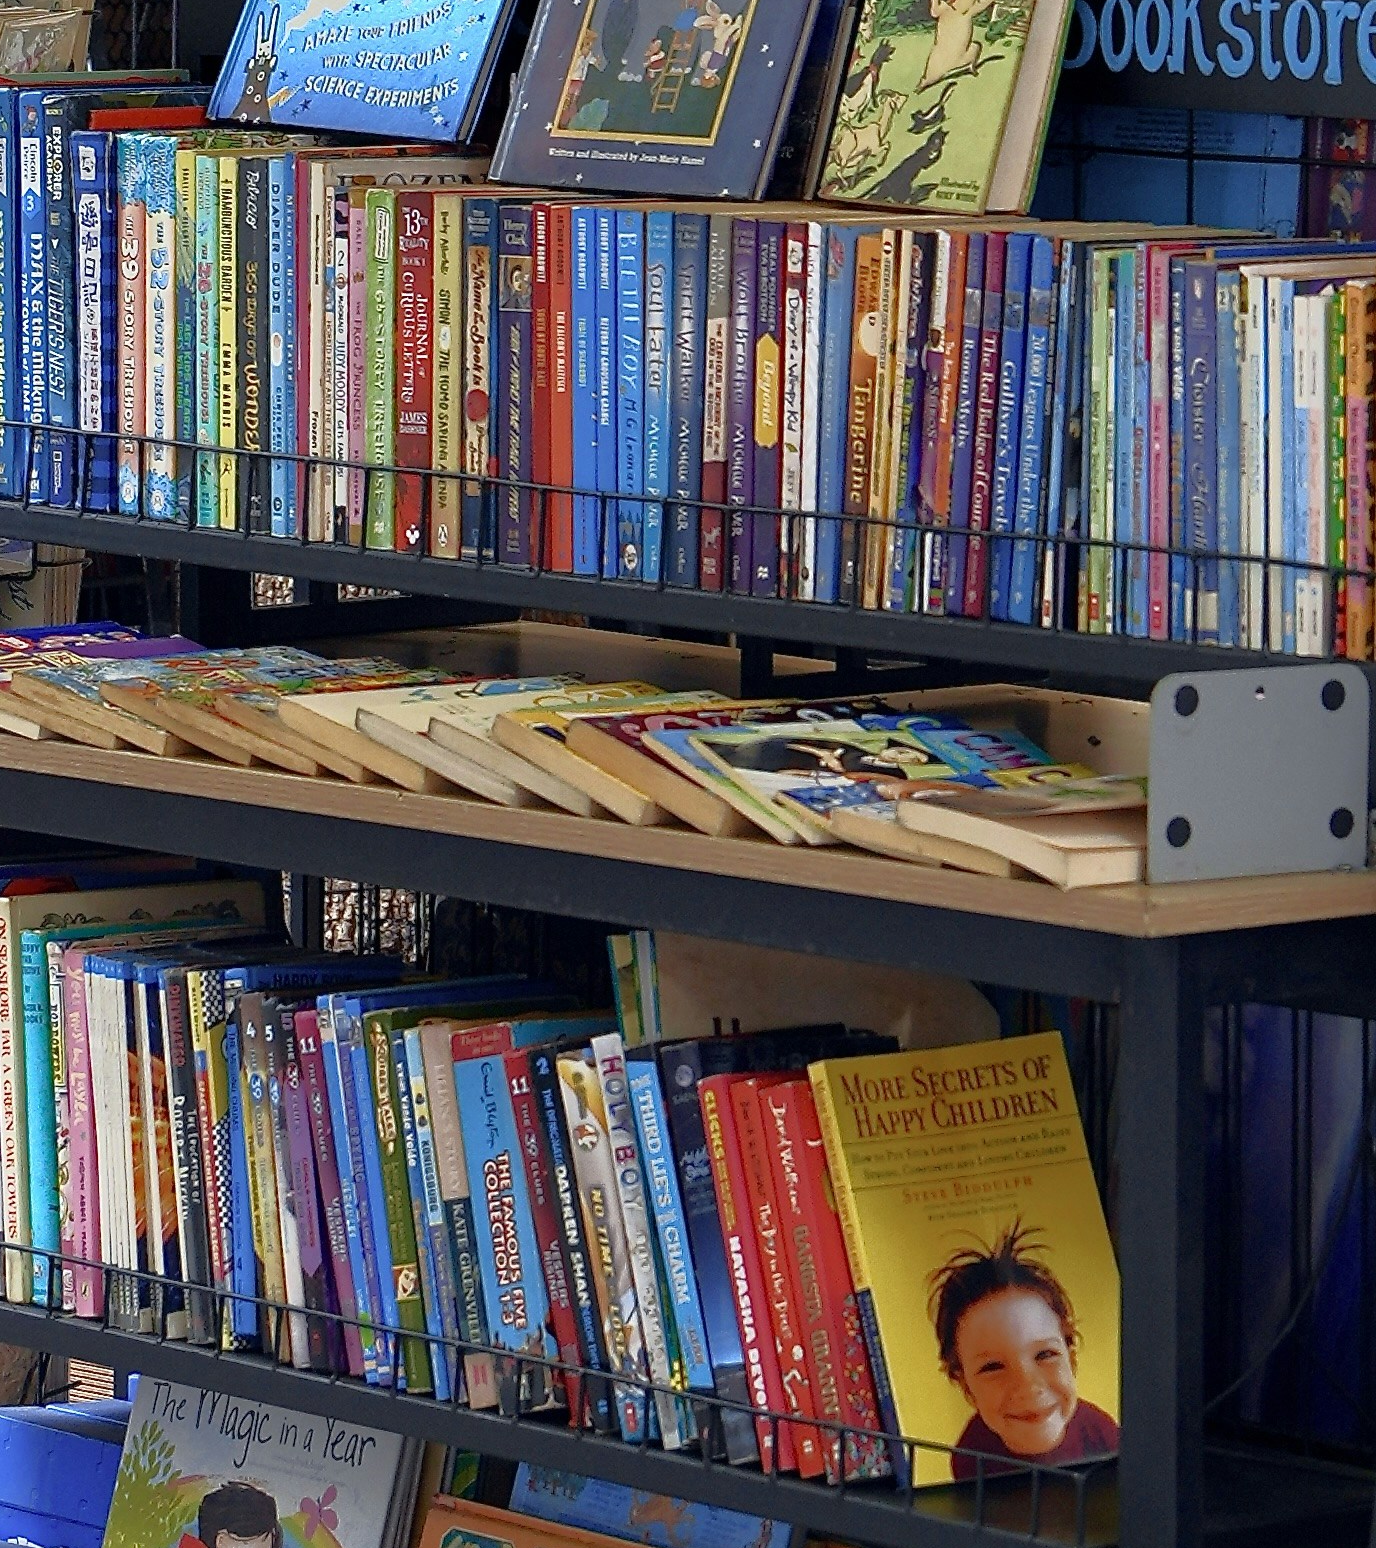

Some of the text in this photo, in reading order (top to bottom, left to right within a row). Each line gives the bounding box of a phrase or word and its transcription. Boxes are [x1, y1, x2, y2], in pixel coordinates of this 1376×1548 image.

[302, 24, 355, 53] AMAZE
[388, 2, 453, 38] FRIENDS
[323, 42, 453, 72] WITH SPECTACULAR
[304, 75, 460, 108] SCIENCE EXPERIMENTS
[840, 1054, 1051, 1105] MORE SECRETS OF
[853, 1088, 1060, 1139] HAPPY CHILDREN
[902, 1175, 1034, 1203] STEVE BIDDULPH
[483, 1159, 509, 1286] COLLECTION
[497, 1152, 529, 1328] THE FAMOUS FIVE
[152, 1382, 376, 1469] The Magic in a Year
